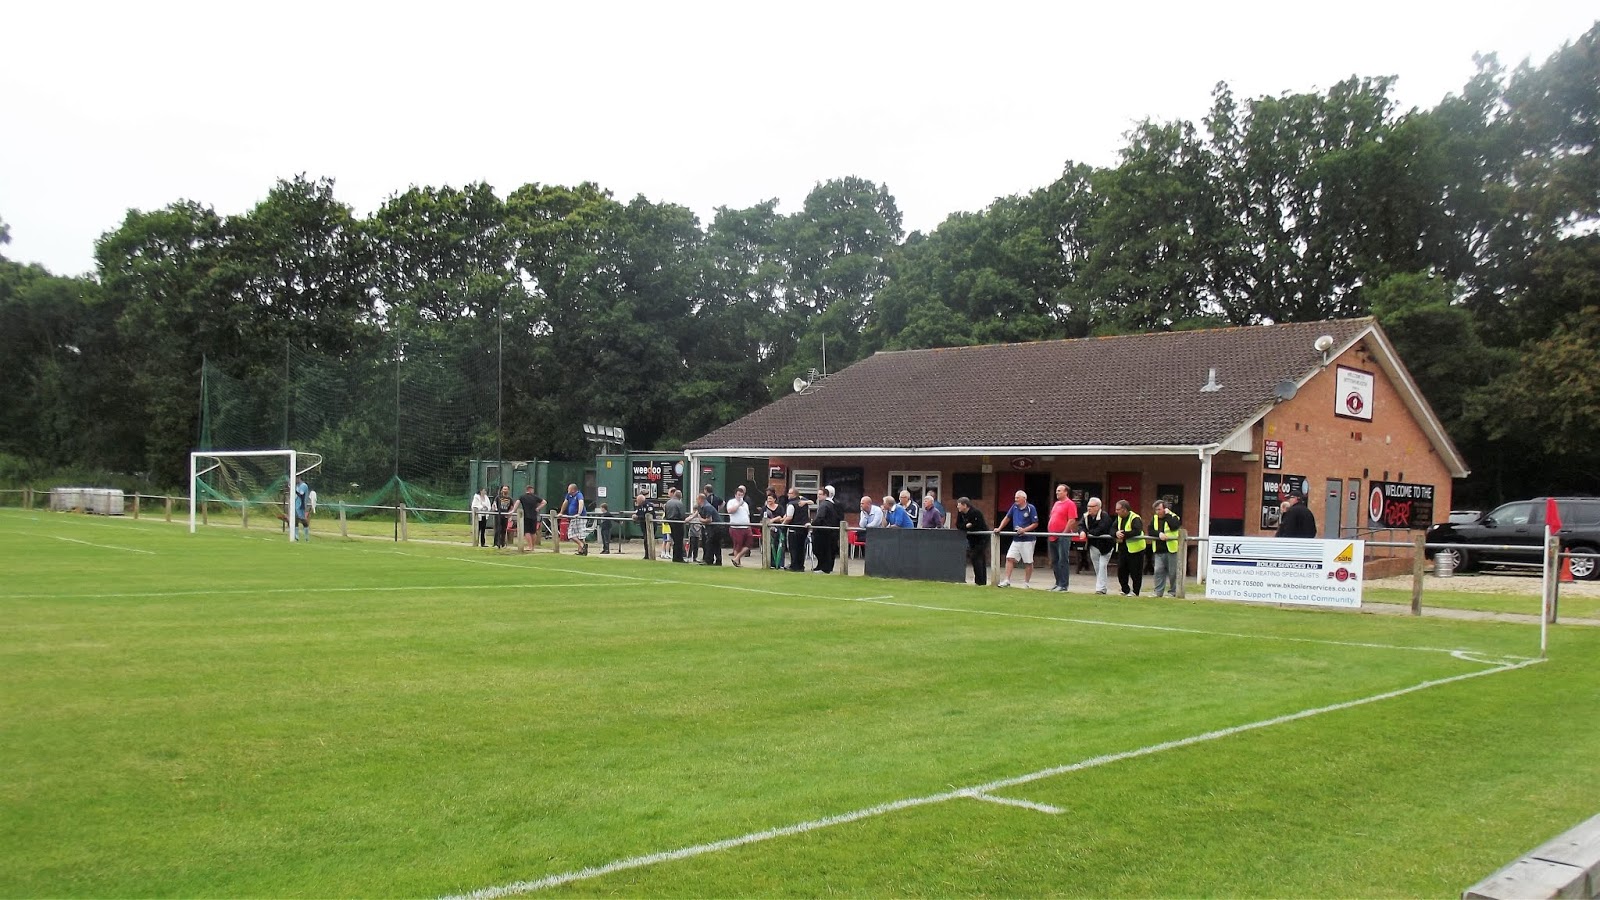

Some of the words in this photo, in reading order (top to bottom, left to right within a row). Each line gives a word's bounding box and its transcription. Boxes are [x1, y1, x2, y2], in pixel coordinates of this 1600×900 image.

[1384, 484, 1412, 498] WELCOME
[1413, 486, 1420, 498] TO
[1421, 487, 1432, 499] THE
[1215, 543, 1242, 554] B&K
[1266, 582, 1356, 592] www.bkboilerservices.co.uk
[1243, 590, 1272, 599] Support
